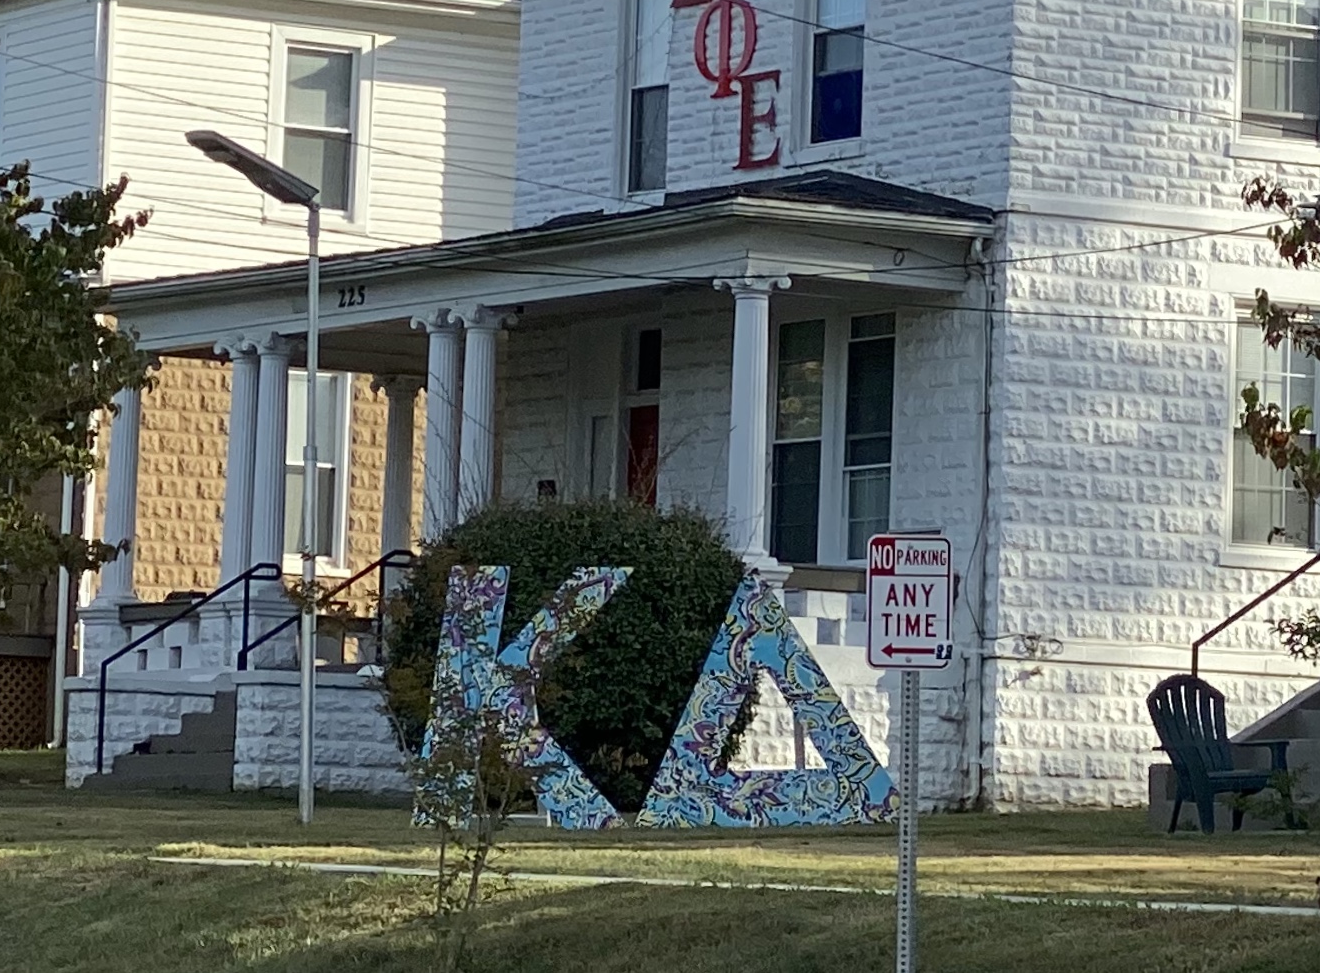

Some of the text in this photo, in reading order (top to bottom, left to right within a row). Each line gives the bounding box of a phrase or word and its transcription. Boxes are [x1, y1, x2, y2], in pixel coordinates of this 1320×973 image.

[338, 286, 365, 308] 225
[871, 544, 947, 571] NO PARKING
[885, 583, 935, 608] ANY
[881, 613, 937, 638] TIME
